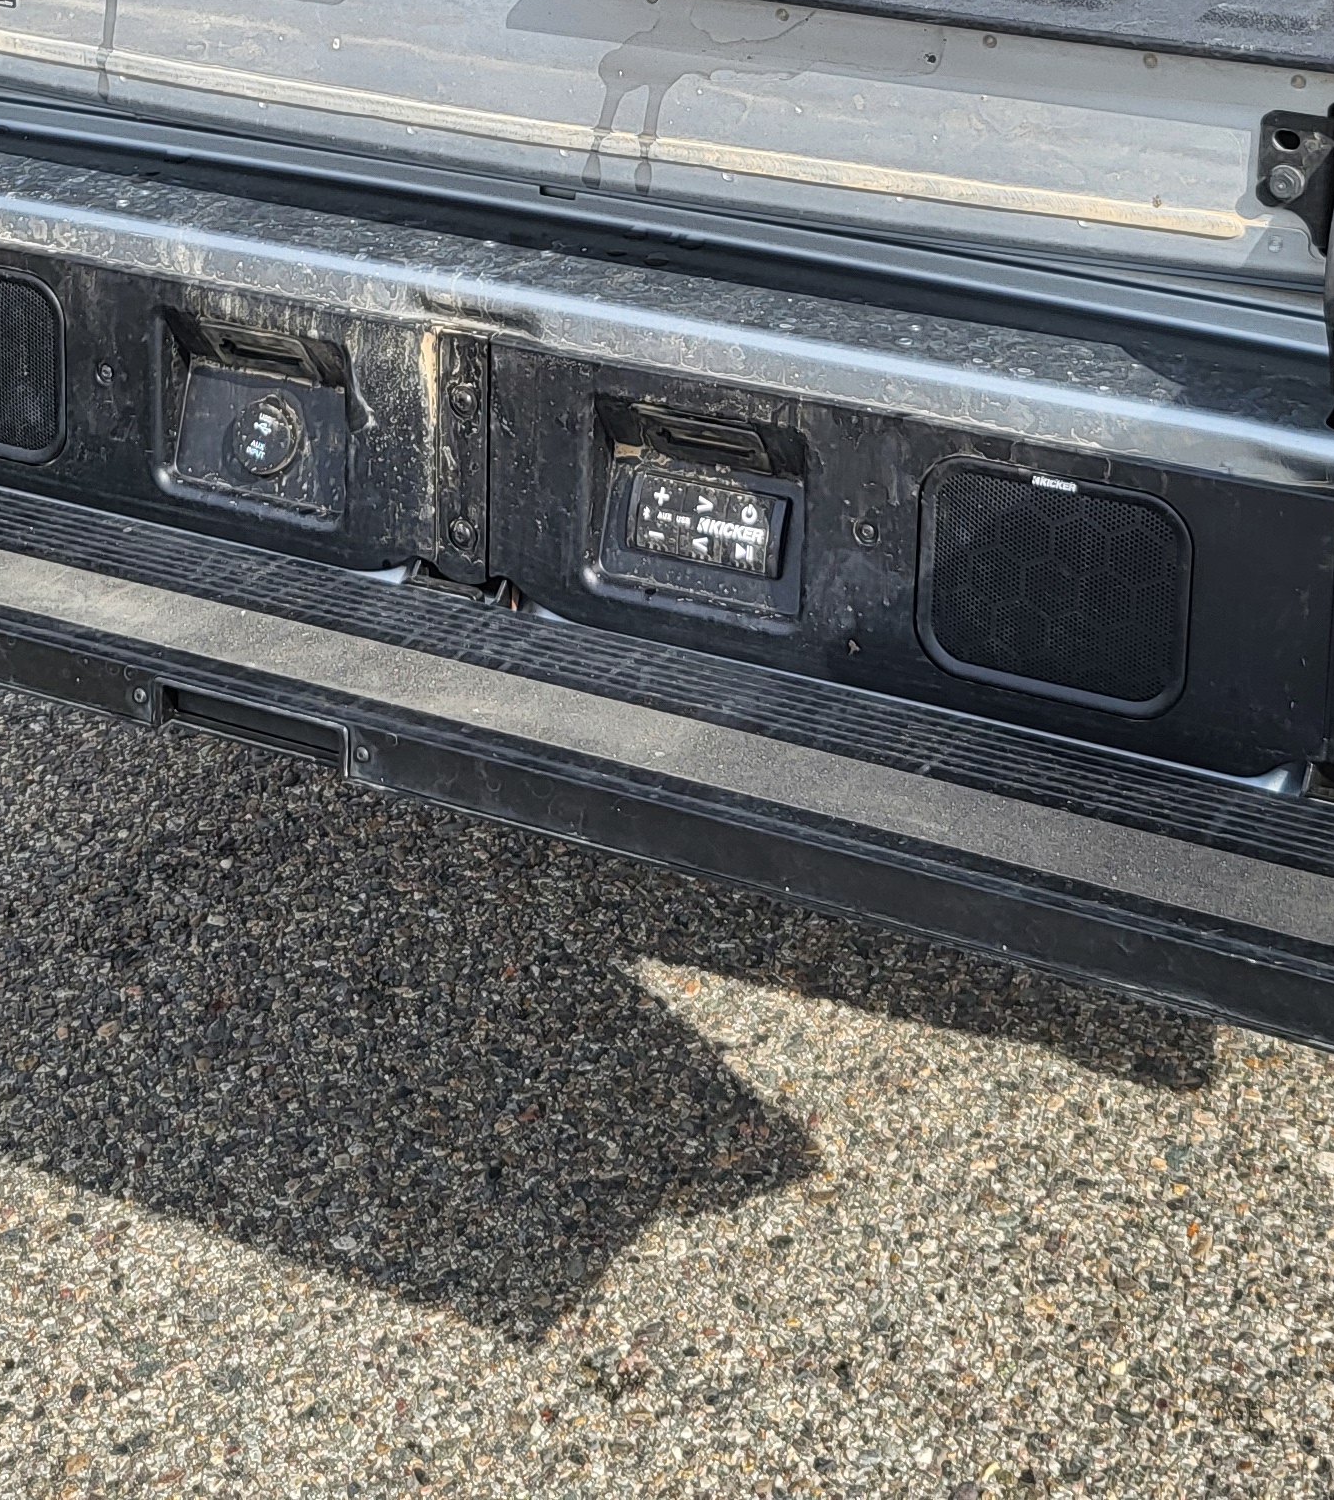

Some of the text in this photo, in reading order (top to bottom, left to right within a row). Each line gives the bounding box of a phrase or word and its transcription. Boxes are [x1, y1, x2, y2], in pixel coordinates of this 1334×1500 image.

[1031, 475, 1077, 493] KICKER
[656, 510, 673, 523] AUX
[705, 518, 766, 545] KICKER
